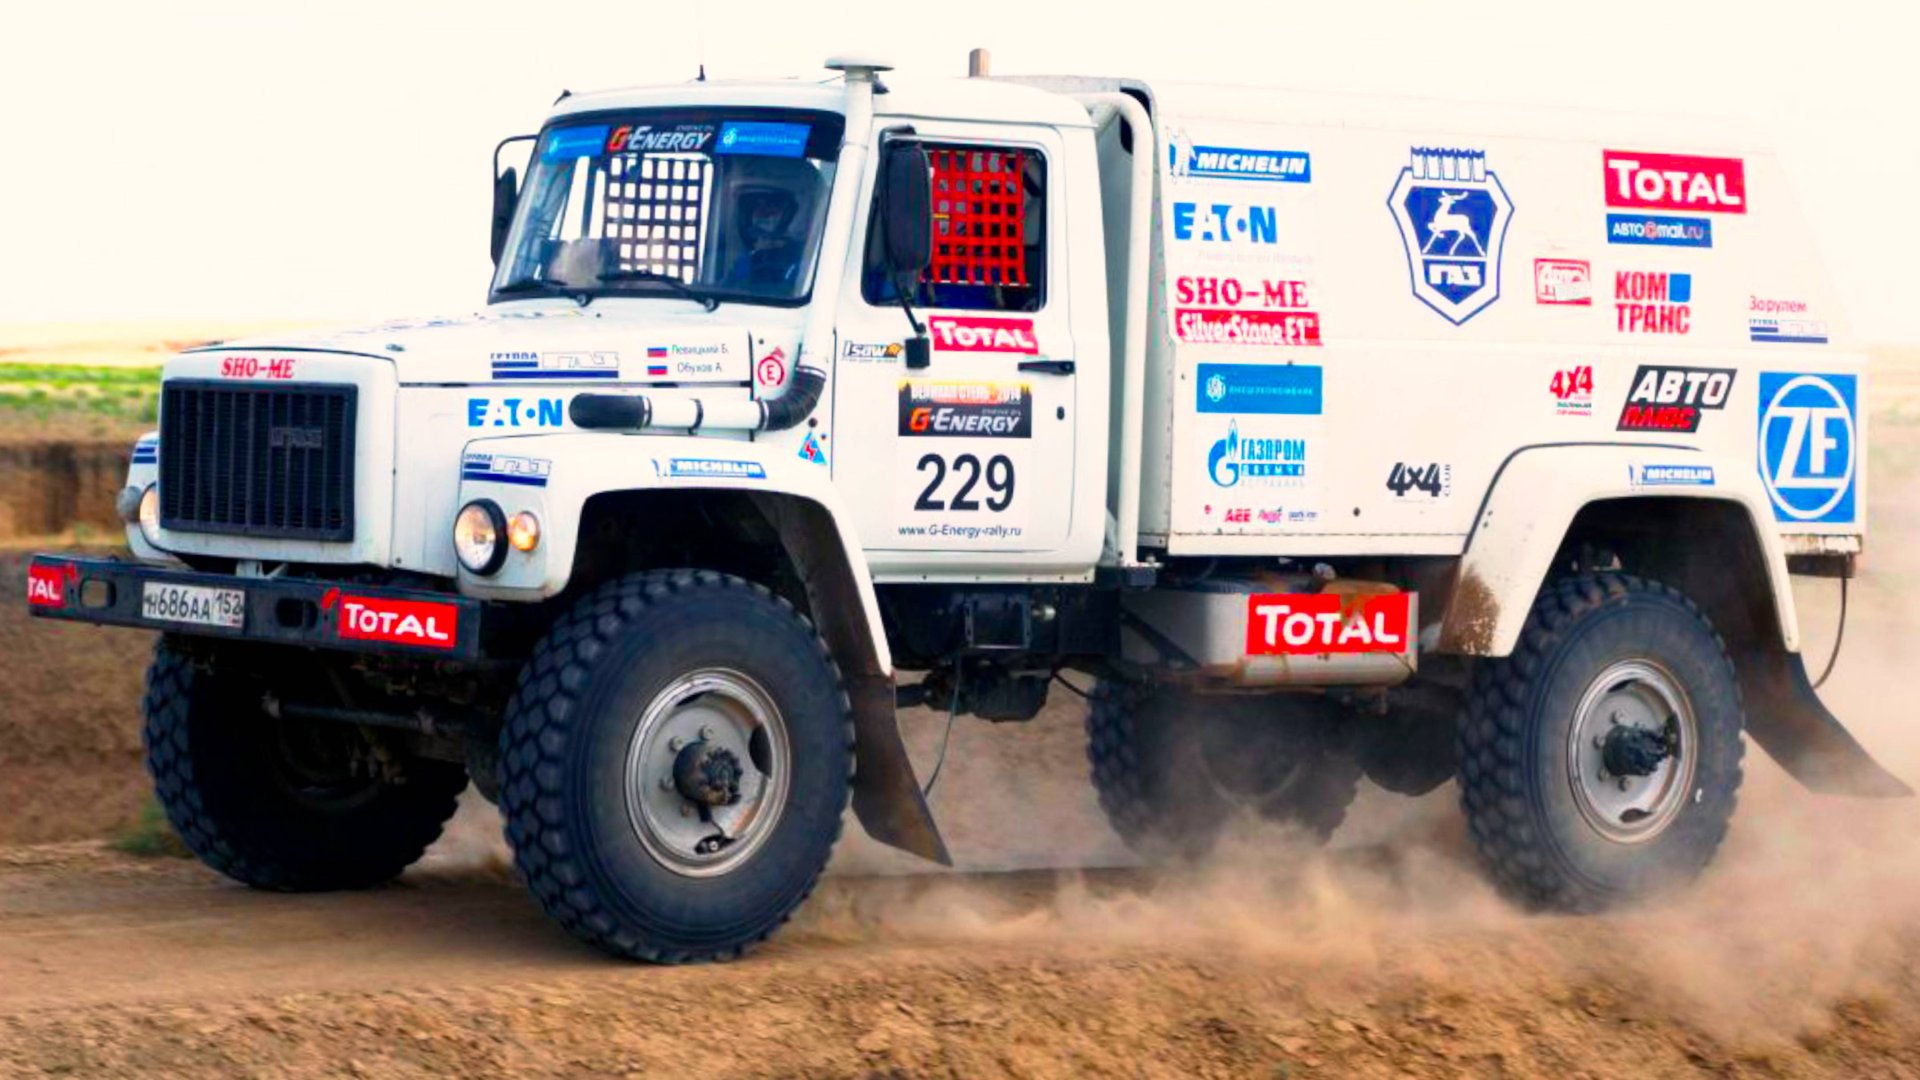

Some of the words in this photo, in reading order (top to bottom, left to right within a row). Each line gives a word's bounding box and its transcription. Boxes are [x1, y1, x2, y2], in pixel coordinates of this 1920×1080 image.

[1197, 152, 1307, 175] MICHELIN
[1607, 158, 1742, 206] TOTAL
[1173, 202, 1277, 244] EATON
[1428, 263, 1481, 286] ГАЗ
[1615, 270, 1667, 302] КОМ
[1176, 275, 1309, 308] SHO-ME
[932, 320, 1035, 349] TOTAL
[1615, 303, 1691, 335] ТРАНС
[221, 357, 296, 379] SHO-ME
[1630, 369, 1731, 406] АВТО
[468, 398, 563, 427] EATON
[1240, 438, 1305, 461] ГАЗПРОМ
[1769, 406, 1849, 489] ZF
[913, 453, 1016, 513] 229
[1647, 468, 1712, 481] MICHELIN
[343, 602, 449, 641] TOTAL
[1255, 604, 1400, 647] TOTAL
